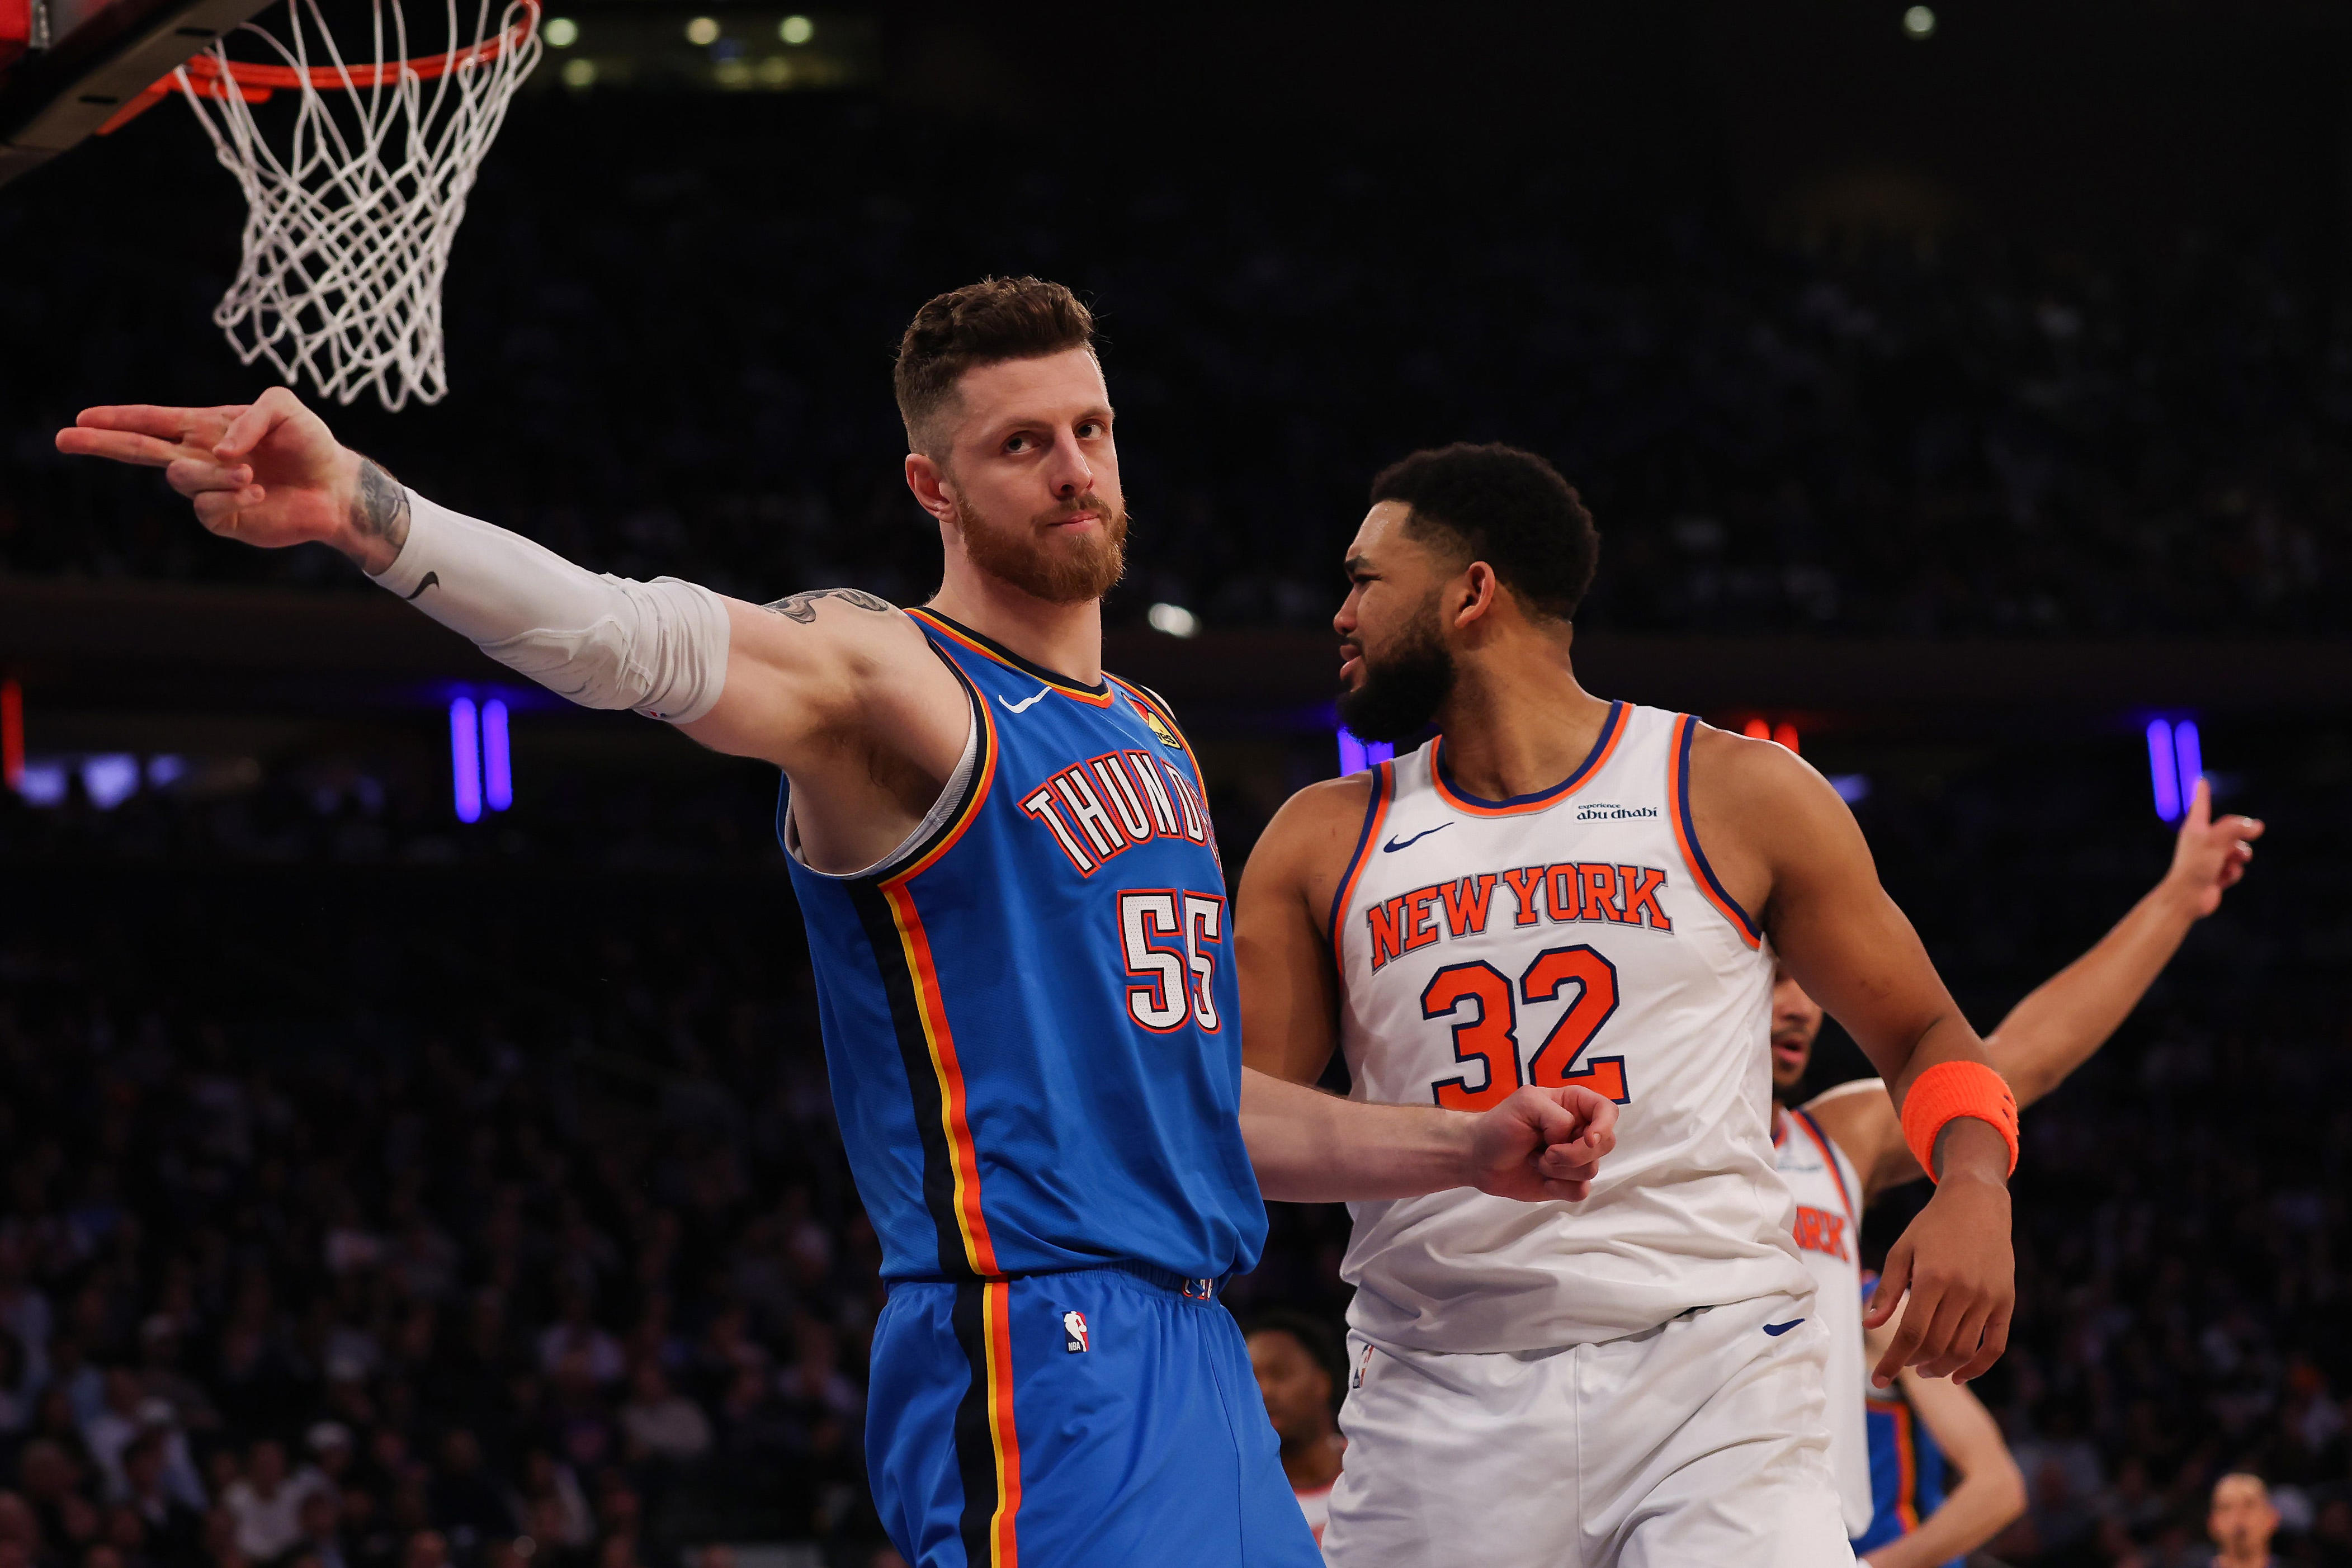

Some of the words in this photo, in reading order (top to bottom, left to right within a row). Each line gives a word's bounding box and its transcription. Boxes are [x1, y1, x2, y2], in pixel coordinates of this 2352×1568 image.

[1017, 750, 1225, 879] THUND
[1577, 809, 1608, 820] abu
[1610, 807, 1659, 820] dhabi
[1117, 889, 1226, 1035] 55
[1366, 870, 1499, 975] NEW
[1503, 862, 1674, 934] YORK
[1420, 944, 1631, 1113] 32
[1794, 1205, 1850, 1264] RK
[1068, 1342, 1081, 1352] NBA
